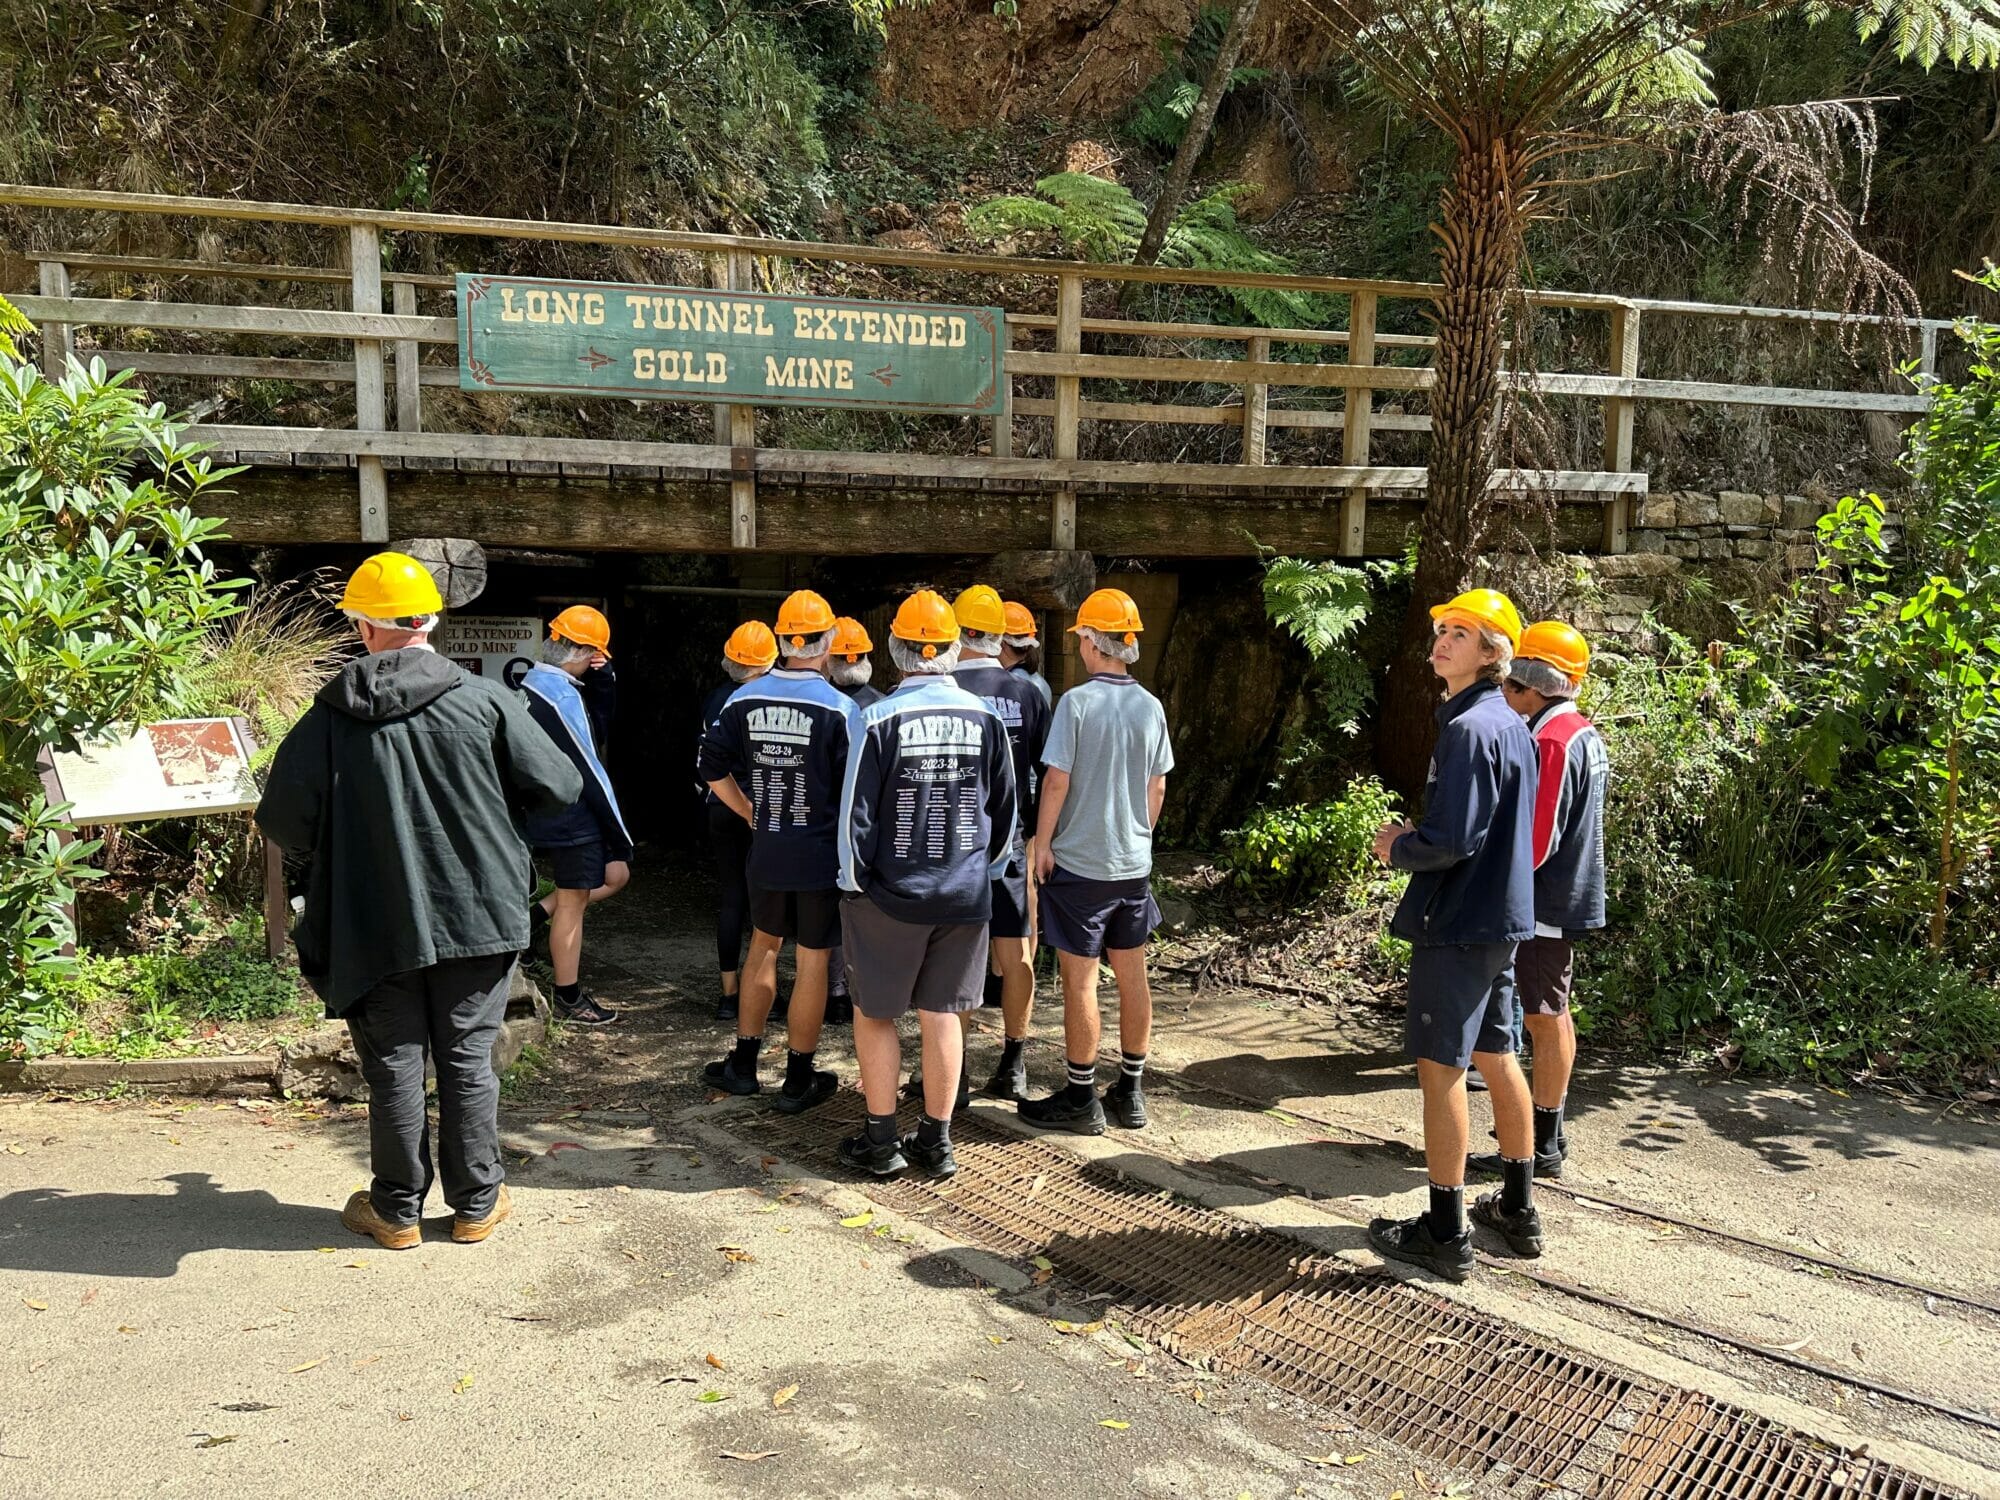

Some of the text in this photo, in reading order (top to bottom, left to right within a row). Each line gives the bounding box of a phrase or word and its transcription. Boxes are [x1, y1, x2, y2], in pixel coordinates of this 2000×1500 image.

[500, 287, 967, 348] LONG TUNNEL EXTENDED
[632, 347, 855, 390] GOLD MINE
[479, 619, 518, 627] Management
[464, 627, 533, 640] EXTENDED
[482, 641, 517, 653] MINE
[746, 705, 813, 737] YARRAM
[898, 715, 982, 747] YARRAM
[761, 743, 793, 756] 2023-24
[920, 758, 959, 770] 2023-24
